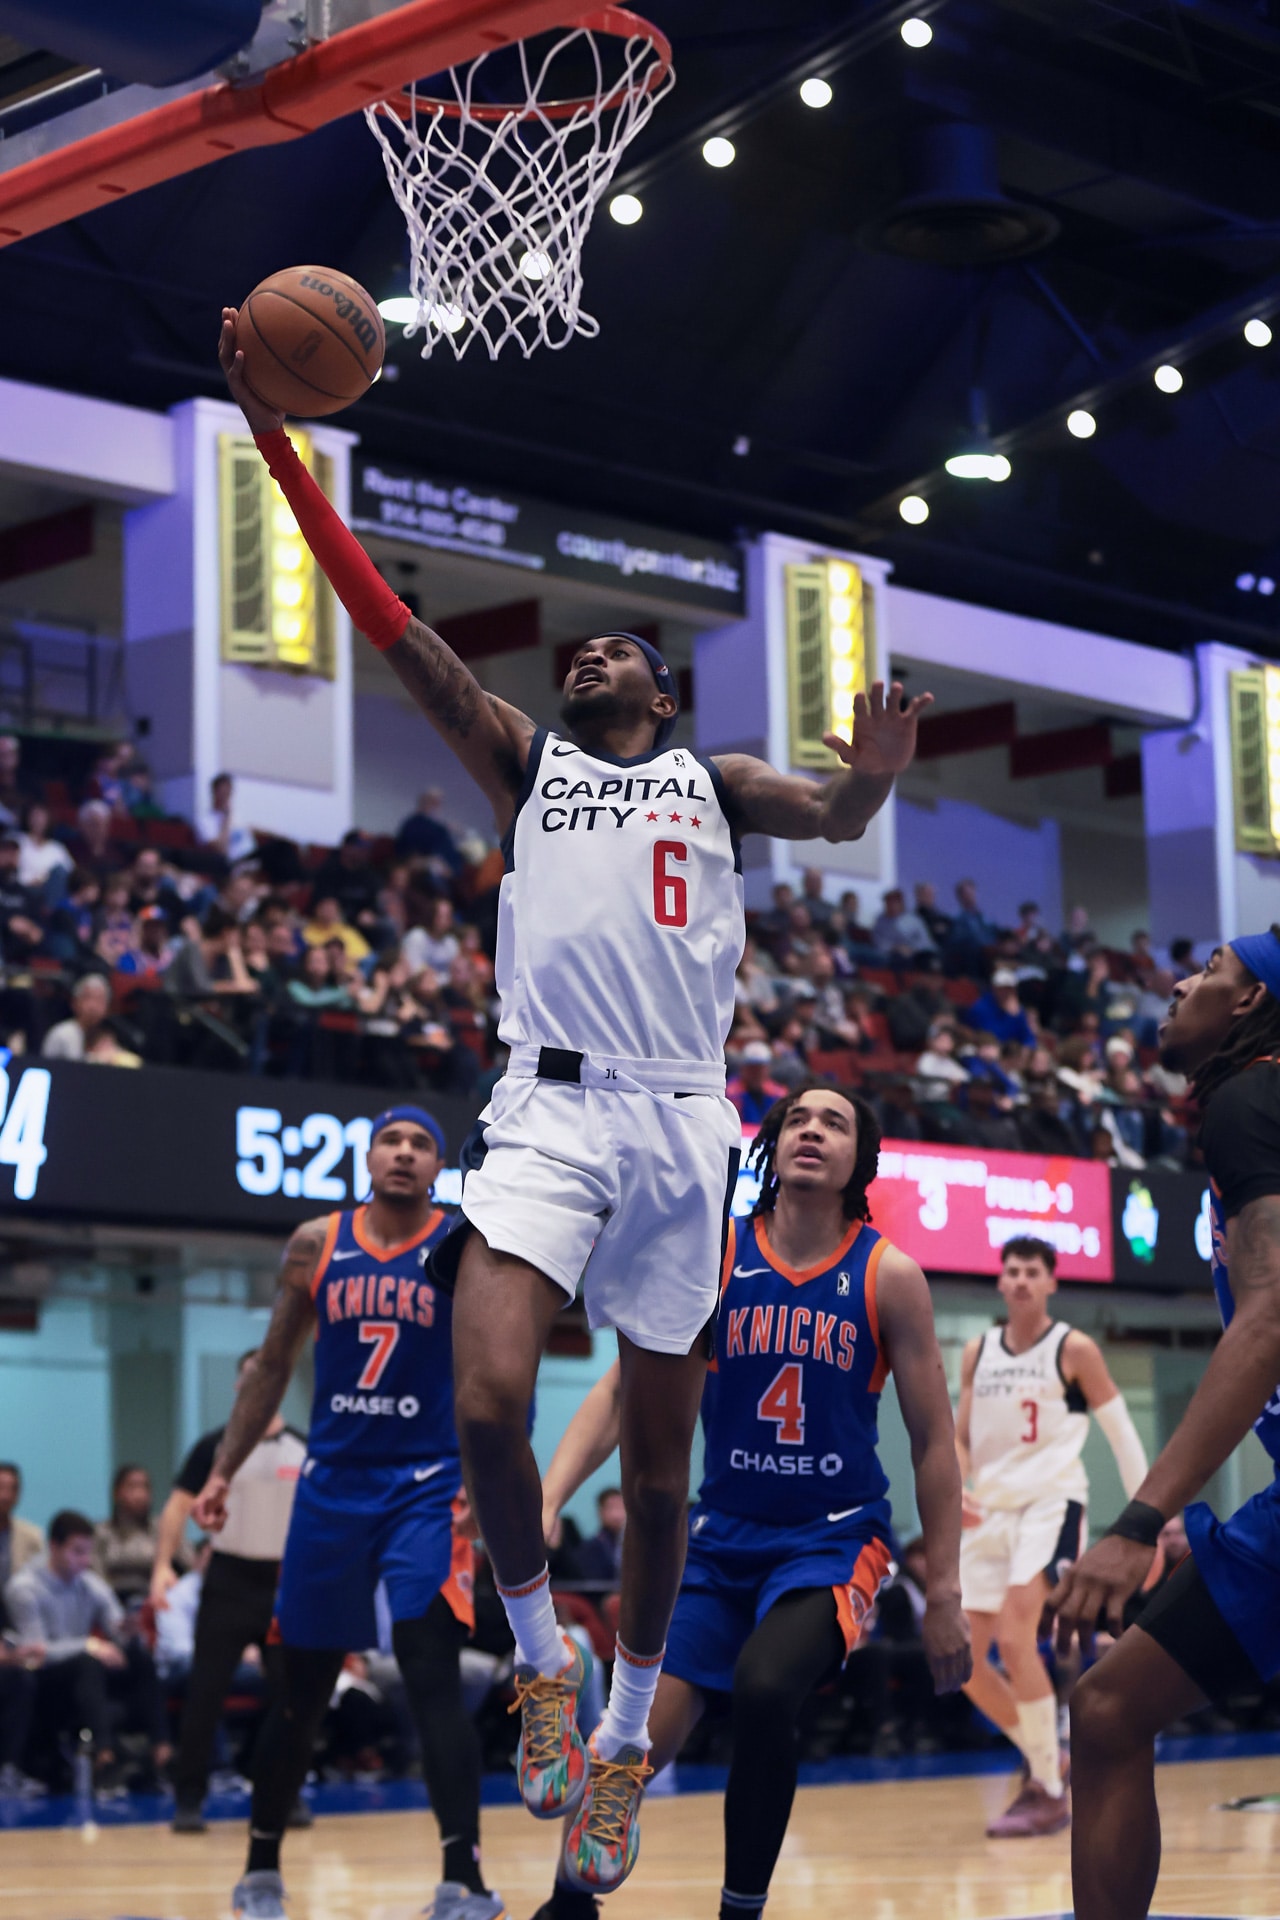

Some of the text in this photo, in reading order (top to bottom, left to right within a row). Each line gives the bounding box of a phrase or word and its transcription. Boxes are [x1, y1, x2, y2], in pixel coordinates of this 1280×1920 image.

[299, 275, 378, 355] Wilson
[541, 777, 707, 802] CAPITAL
[541, 806, 637, 832] CITY
[653, 839, 688, 928] 6
[0, 1066, 52, 1200] 4
[236, 1106, 375, 1201] 5:21
[326, 1275, 435, 1327] KNICKS
[357, 1321, 399, 1389] 7
[727, 1305, 857, 1372] KNICKS
[331, 1394, 395, 1416] CHASE
[757, 1362, 805, 1446] 4
[1020, 1398, 1038, 1443] 3
[730, 1449, 814, 1475] CHASE
